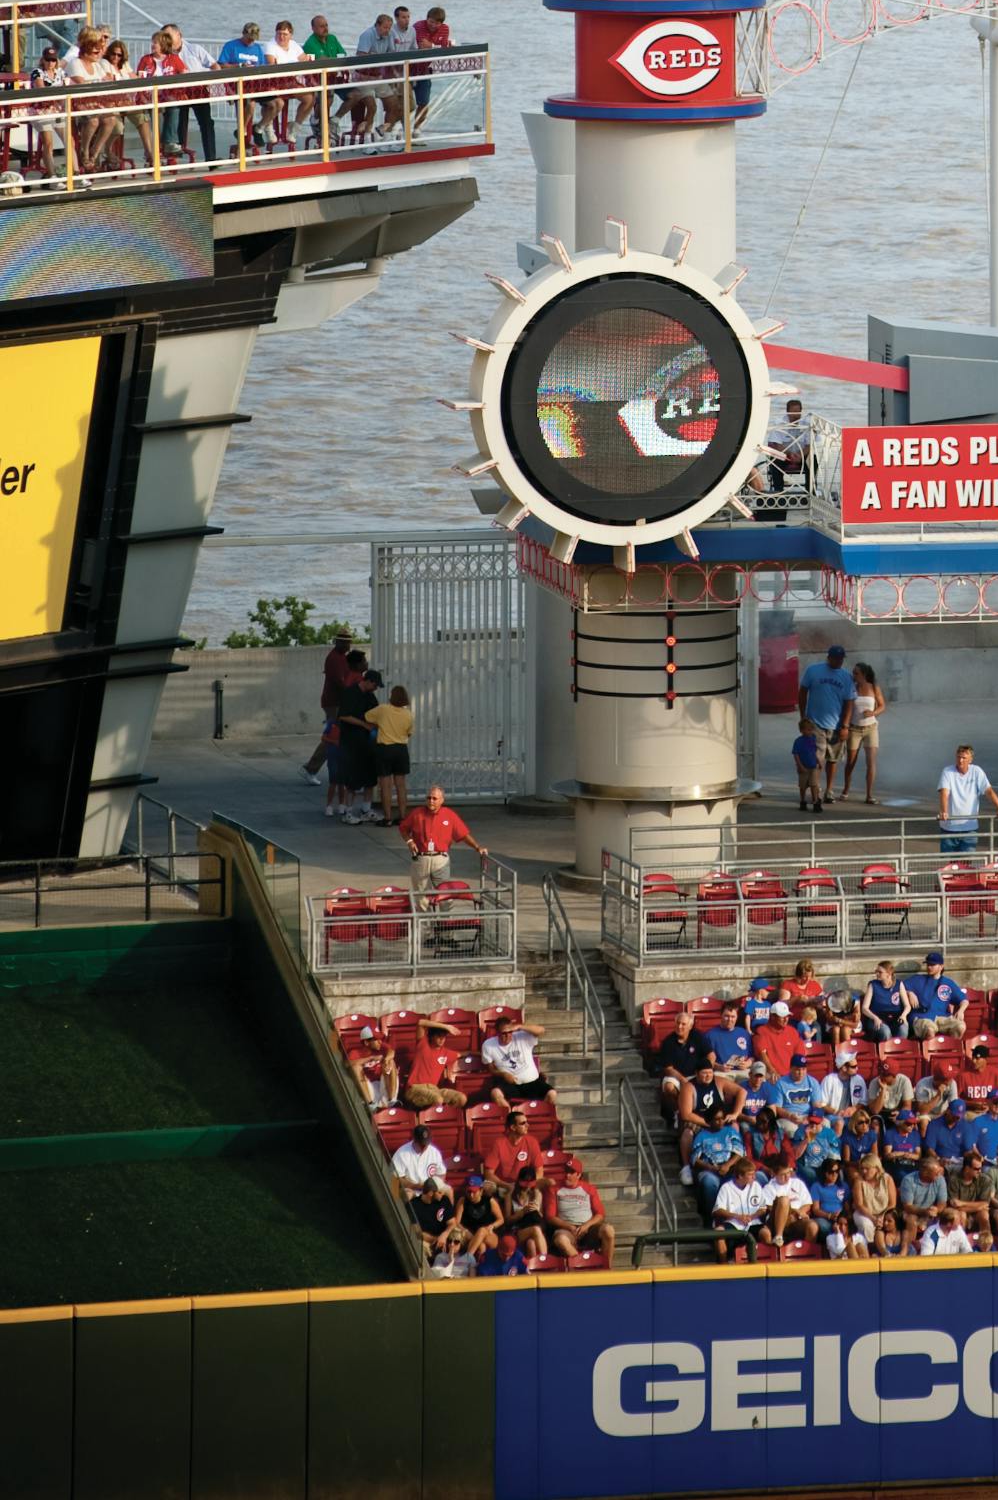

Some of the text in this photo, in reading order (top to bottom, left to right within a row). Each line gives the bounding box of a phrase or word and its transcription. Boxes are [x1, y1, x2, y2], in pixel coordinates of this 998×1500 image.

[648, 47, 722, 69] REDS
[852, 439, 873, 467] A
[883, 436, 959, 467] REDS
[0, 462, 36, 496] er
[860, 481, 882, 510] A
[891, 479, 947, 509] FAN
